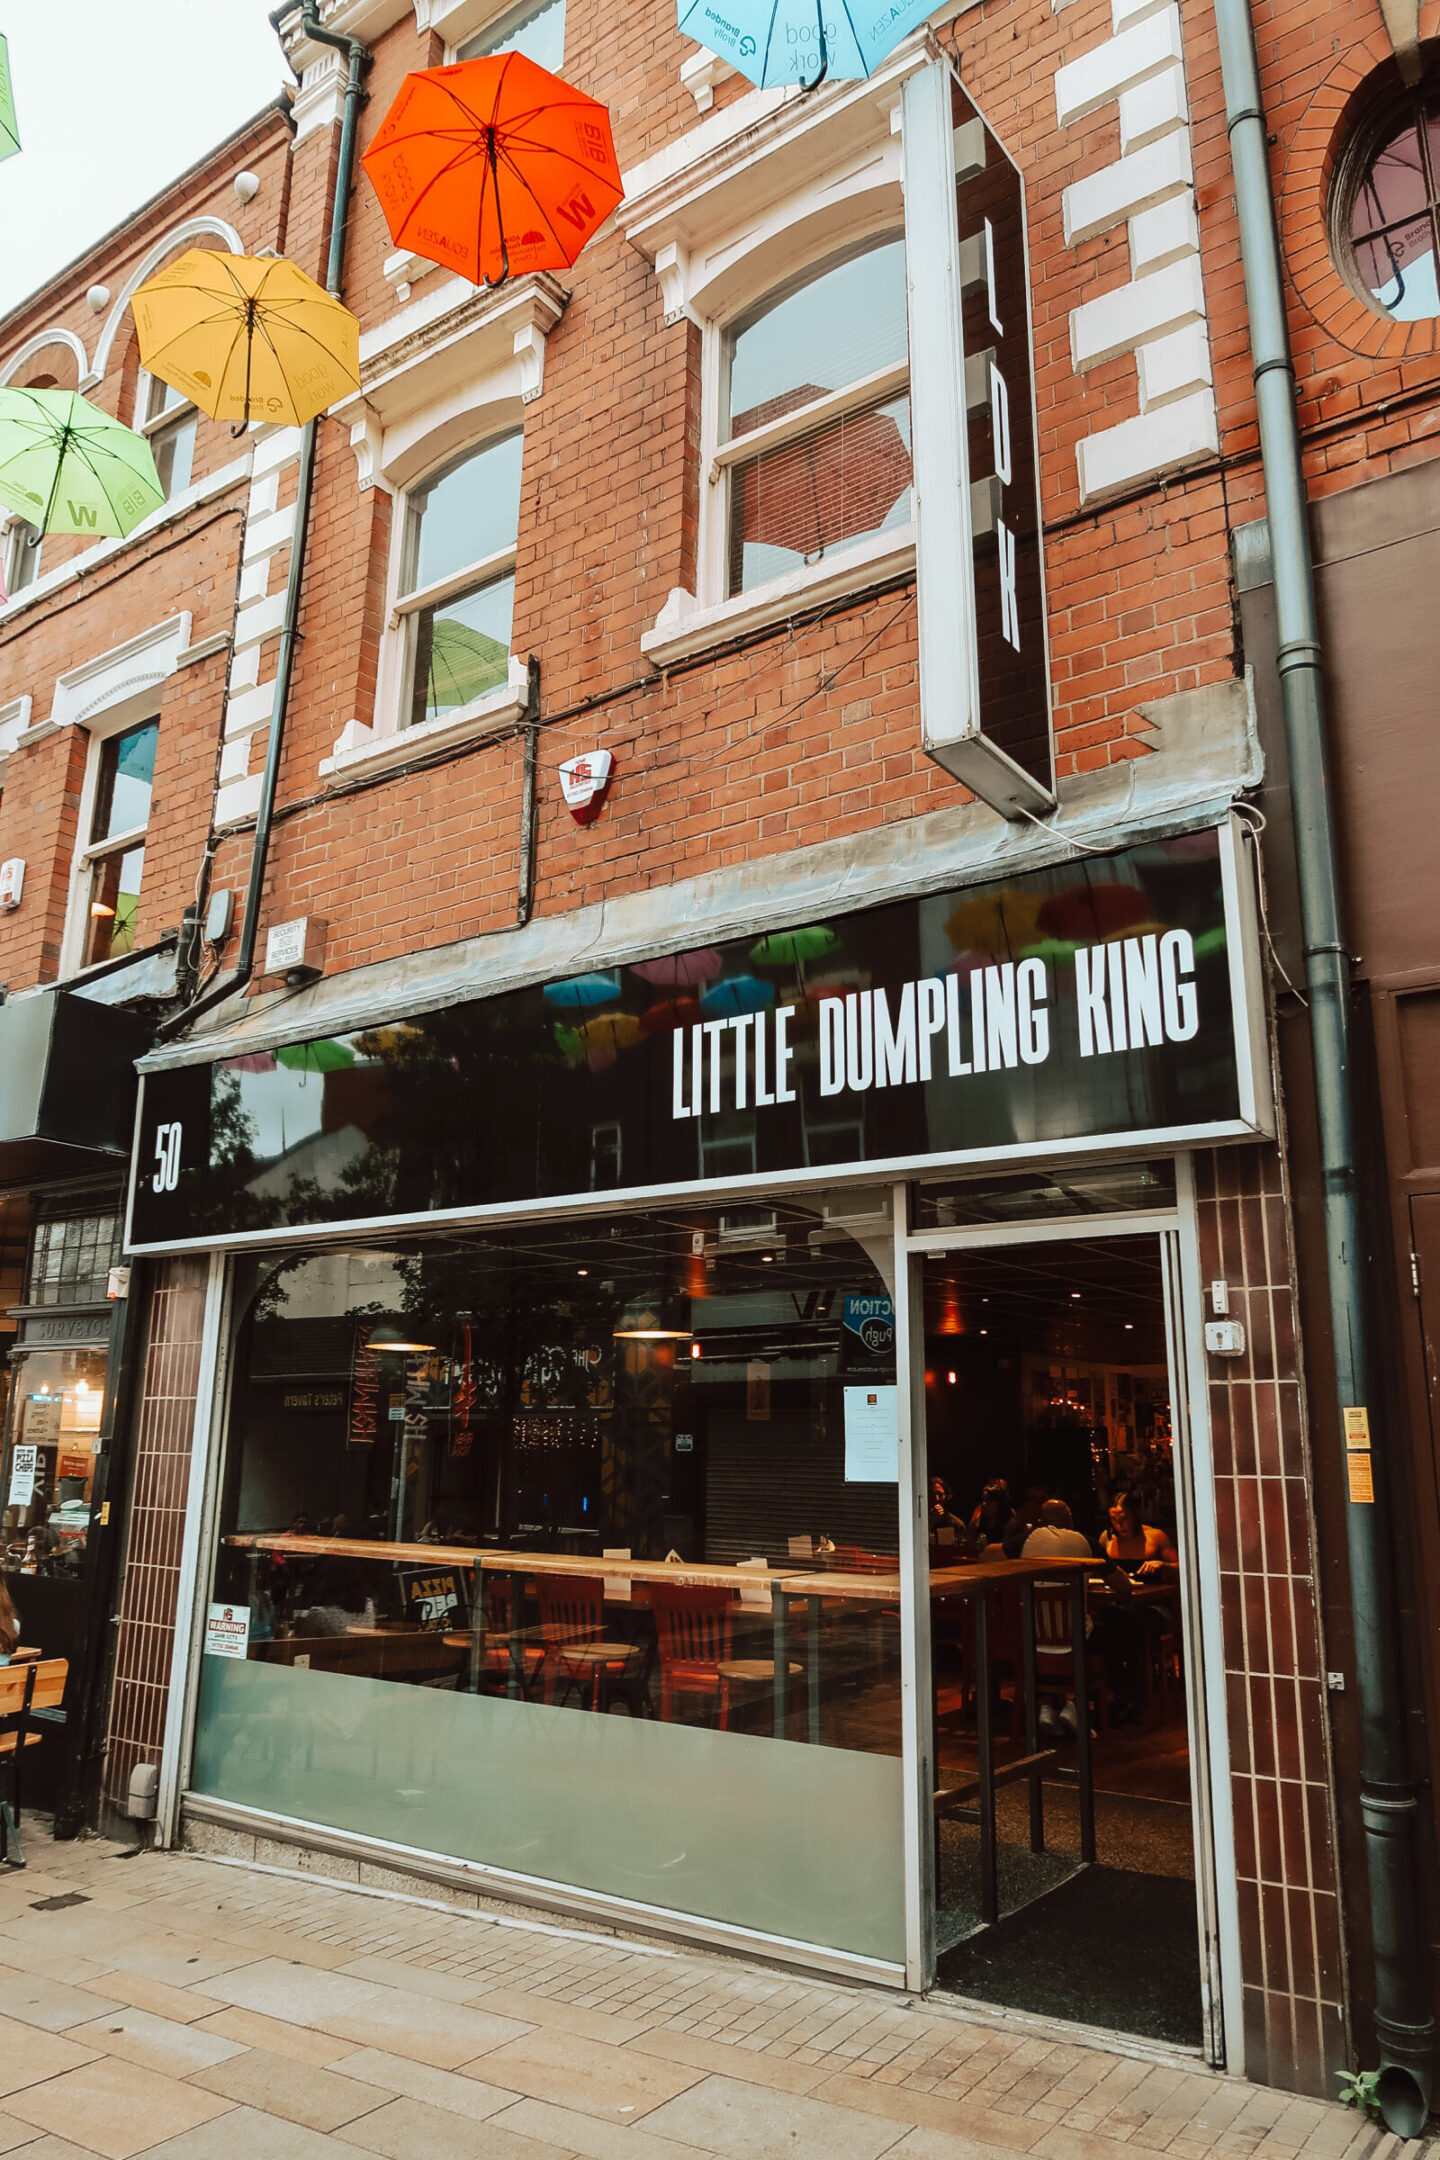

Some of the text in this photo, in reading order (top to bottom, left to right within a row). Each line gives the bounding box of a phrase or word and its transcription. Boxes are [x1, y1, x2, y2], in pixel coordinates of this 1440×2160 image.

[556, 193, 596, 231] W
[67, 499, 97, 528] W
[672, 928, 1200, 1120] LITTLE DUMPLING KING
[152, 1121, 183, 1193] 50
[210, 1621, 245, 1633] WARNING
